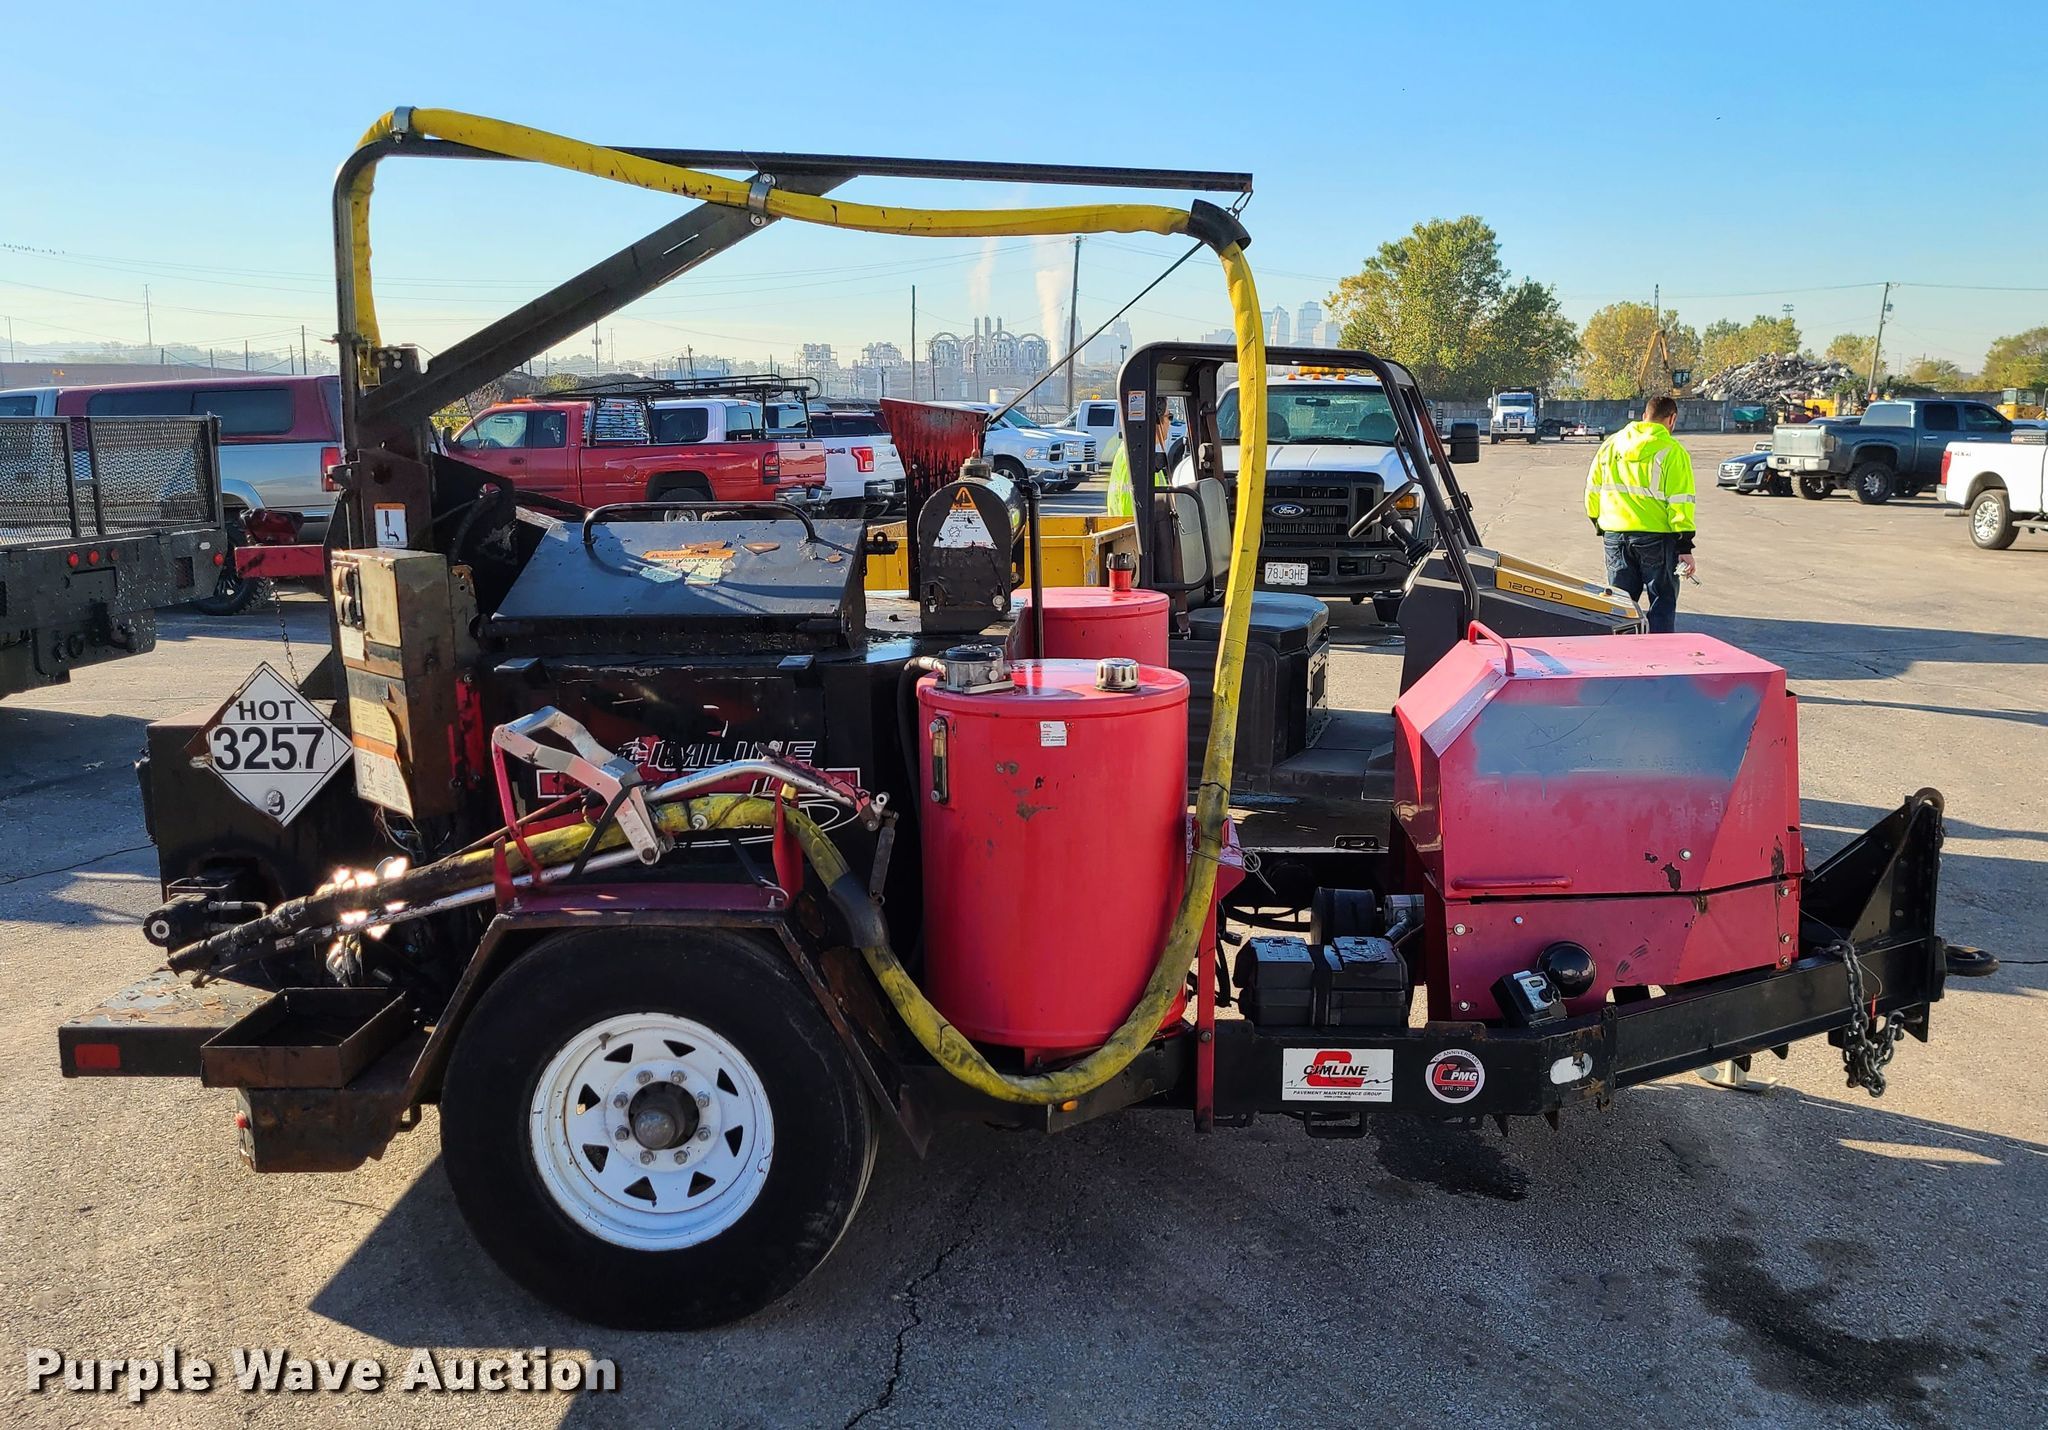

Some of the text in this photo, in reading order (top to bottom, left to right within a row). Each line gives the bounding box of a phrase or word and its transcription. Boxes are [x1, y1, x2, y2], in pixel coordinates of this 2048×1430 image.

[1278, 505, 1297, 515] Ford
[1508, 581, 1563, 601] 1200 D
[237, 700, 296, 721] HOT
[213, 726, 325, 771] 3257
[267, 790, 286, 816] 9
[1443, 1050, 1480, 1065] ANNIVERSARY
[1303, 1064, 1370, 1076] CIMLINE
[1450, 1071, 1478, 1081] PMG
